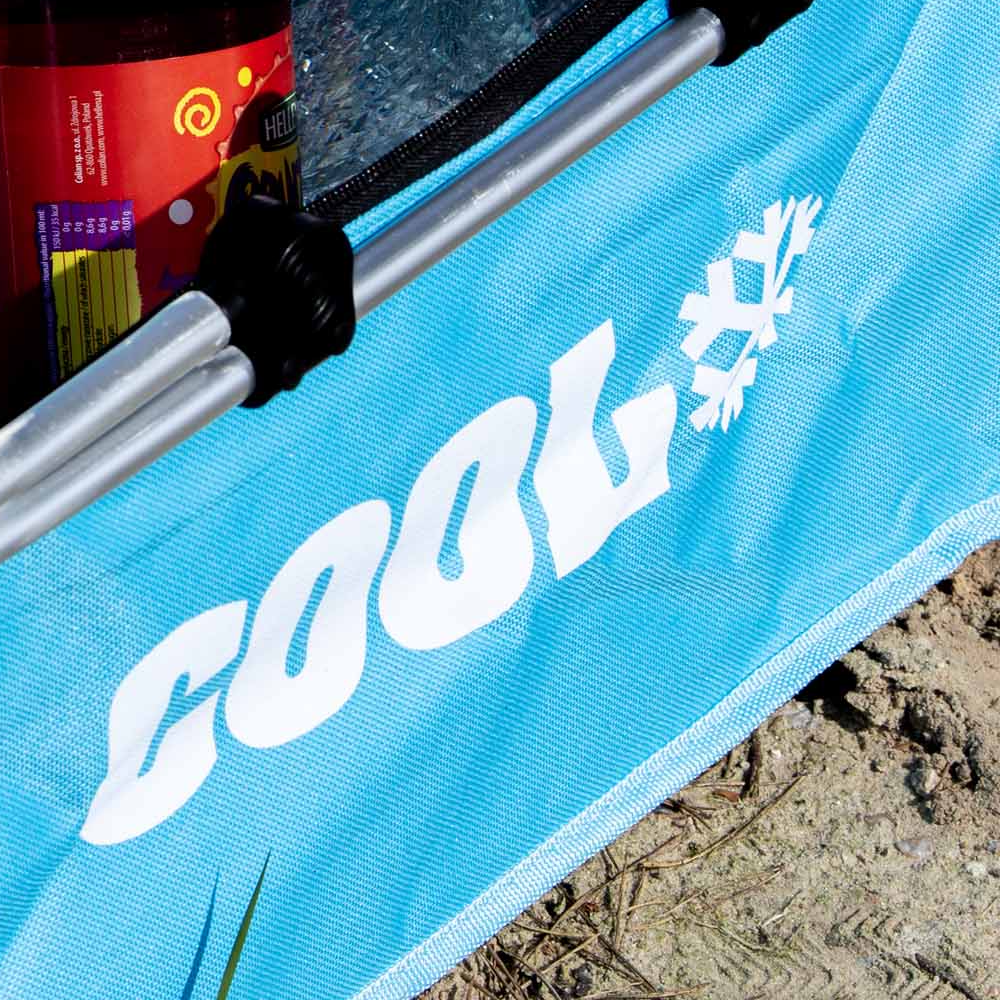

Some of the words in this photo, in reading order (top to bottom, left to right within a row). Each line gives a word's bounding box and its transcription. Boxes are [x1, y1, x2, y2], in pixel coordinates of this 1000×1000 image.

[81, 102, 92, 123] Poland
[38, 221, 46, 233] 100
[80, 318, 677, 845] COOL
